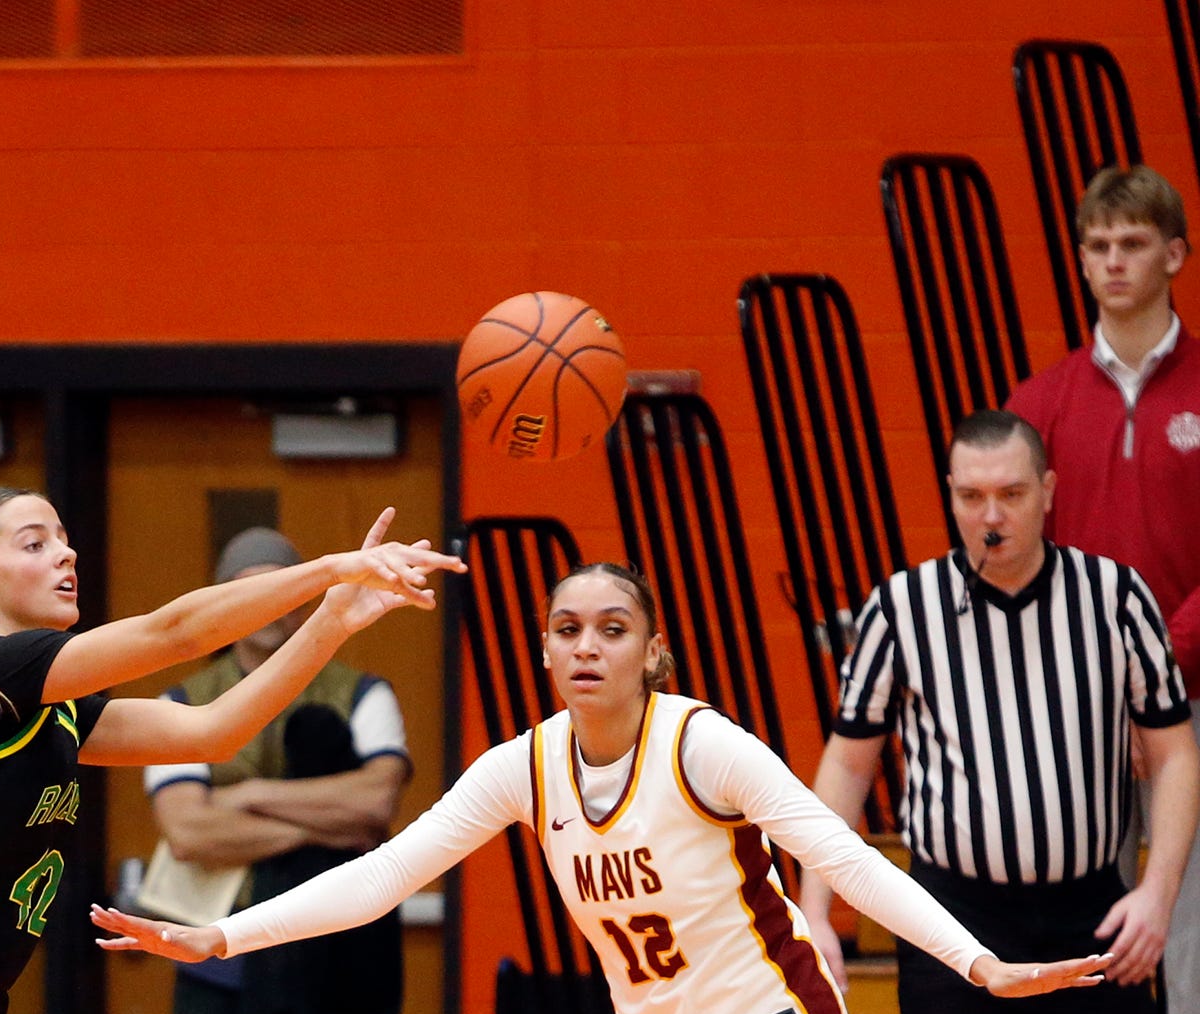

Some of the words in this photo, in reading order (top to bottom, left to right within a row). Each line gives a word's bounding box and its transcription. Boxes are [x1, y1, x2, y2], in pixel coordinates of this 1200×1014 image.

[9, 848, 65, 938] 42
[573, 846, 663, 903] MAVS
[599, 911, 691, 987] 12
